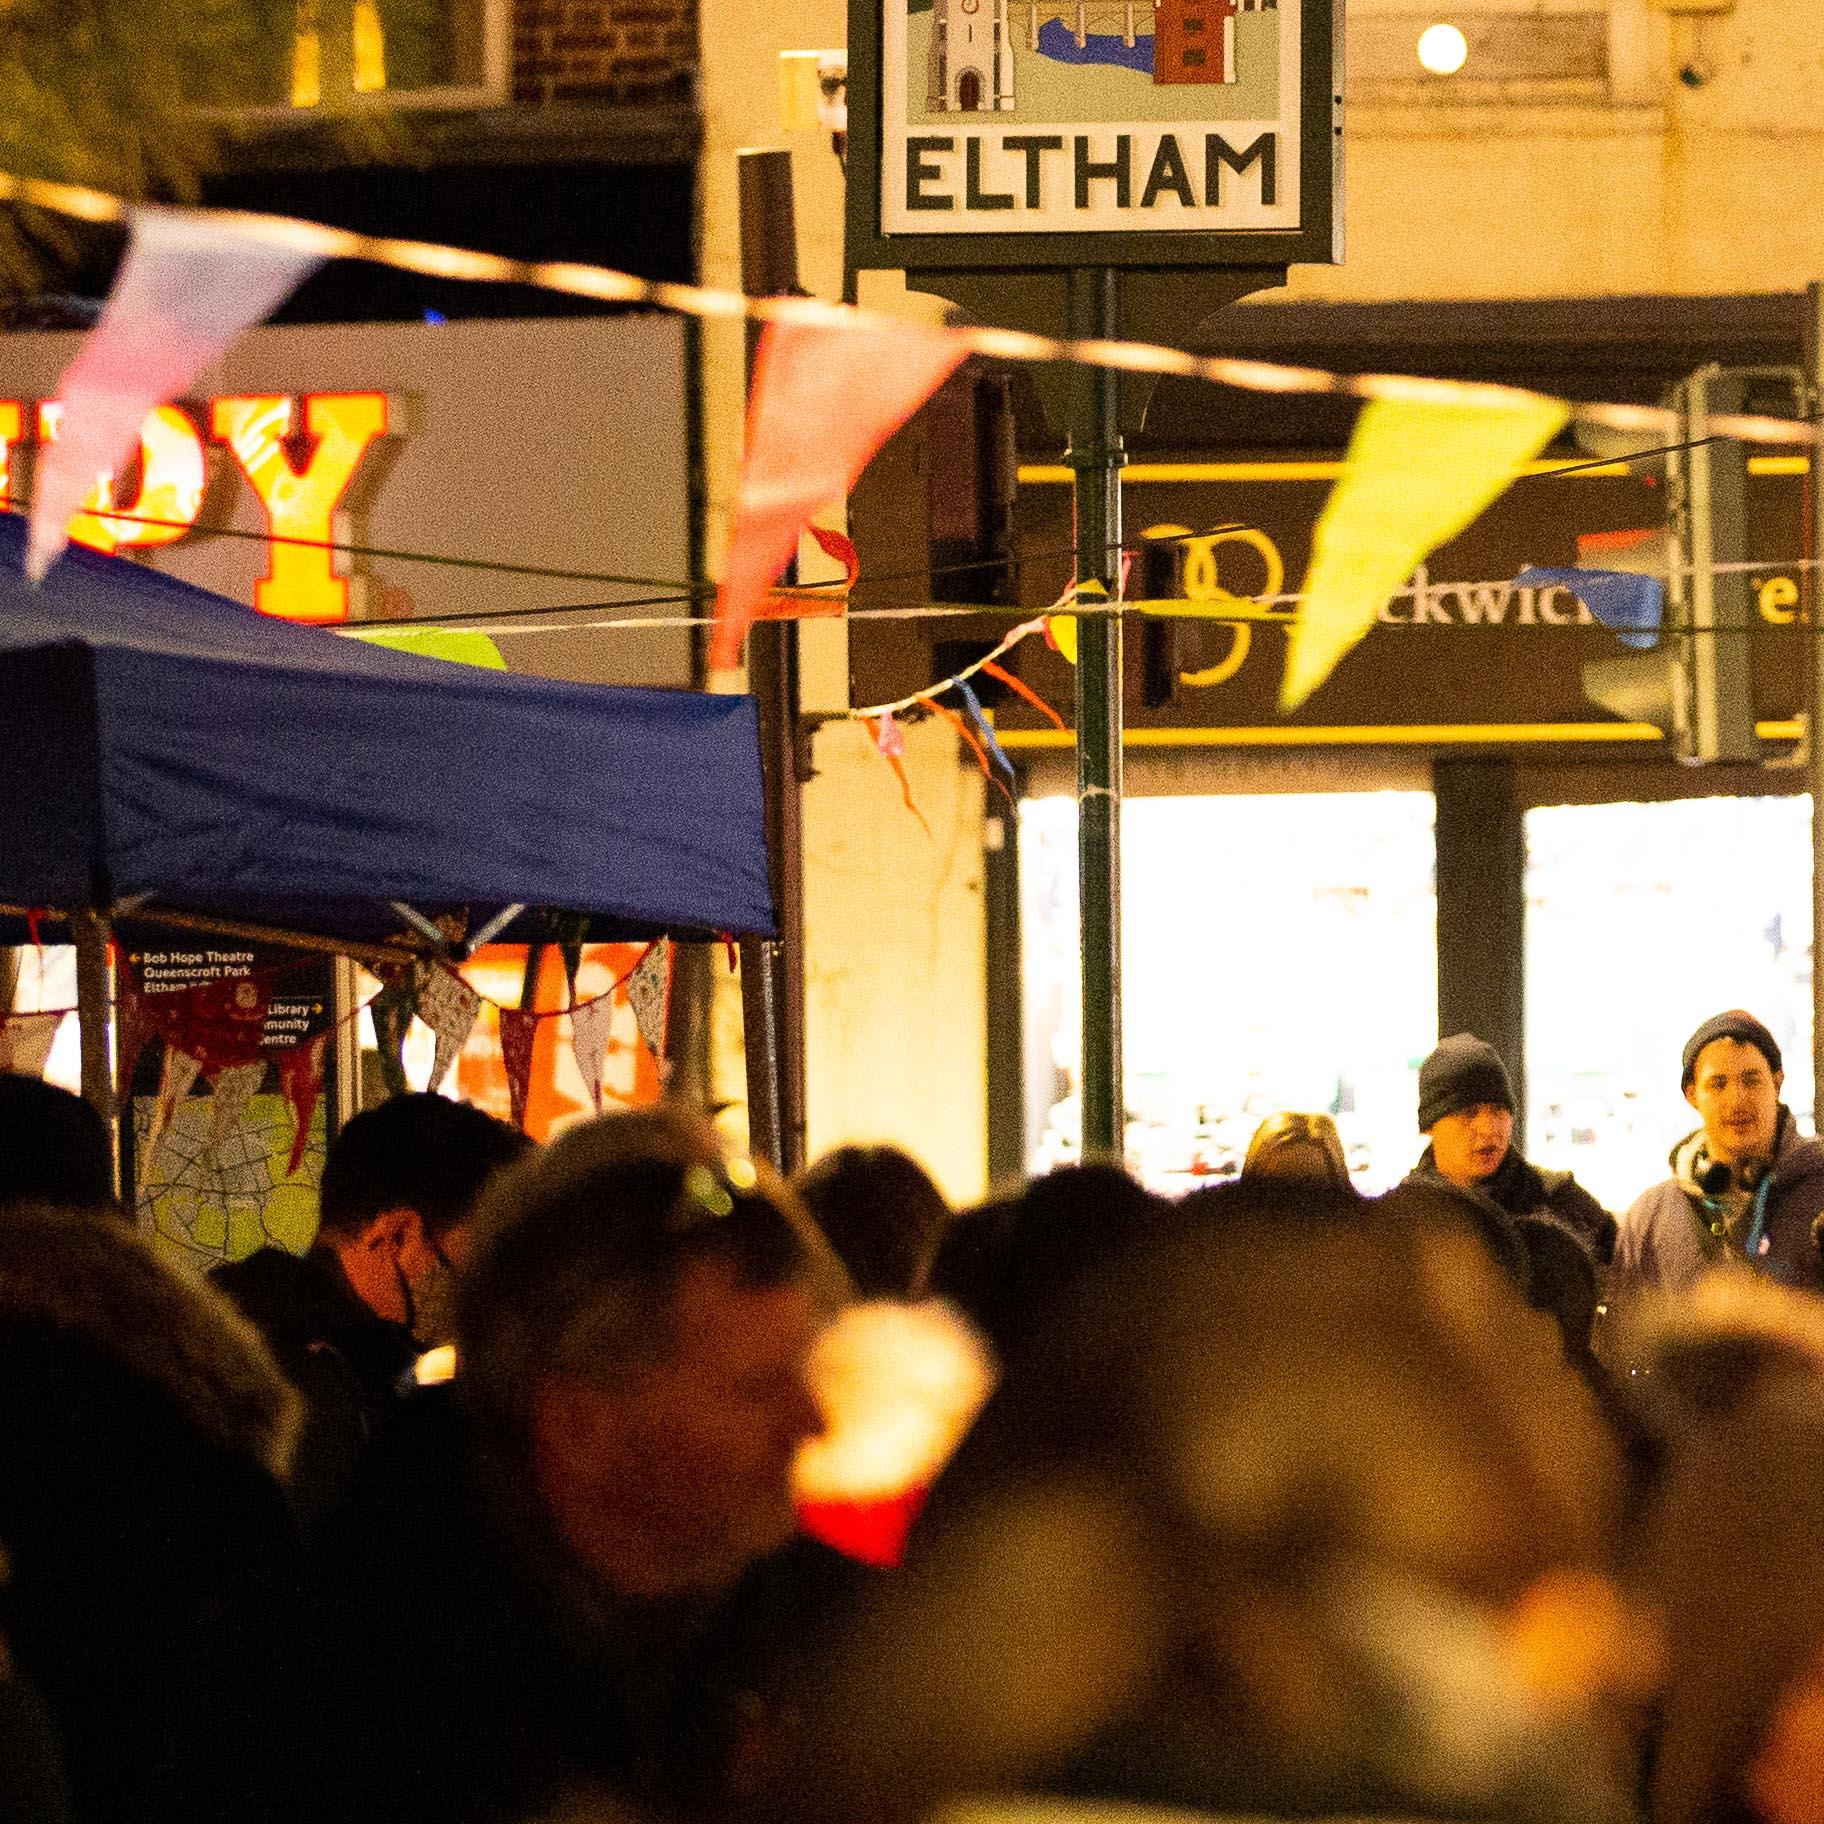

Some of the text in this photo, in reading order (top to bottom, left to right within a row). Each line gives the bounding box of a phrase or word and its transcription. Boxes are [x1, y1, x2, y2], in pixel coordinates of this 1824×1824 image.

[905, 131, 1277, 211] ELTHAM
[0, 390, 389, 625] DY
[1374, 564, 1606, 627] ckwic
[143, 950, 255, 965] Bob Hope Theatre
[143, 965, 251, 978] Queenscroft Park
[143, 981, 187, 994] Eltham
[268, 1003, 310, 1017] Library
[263, 1019, 310, 1032] munity
